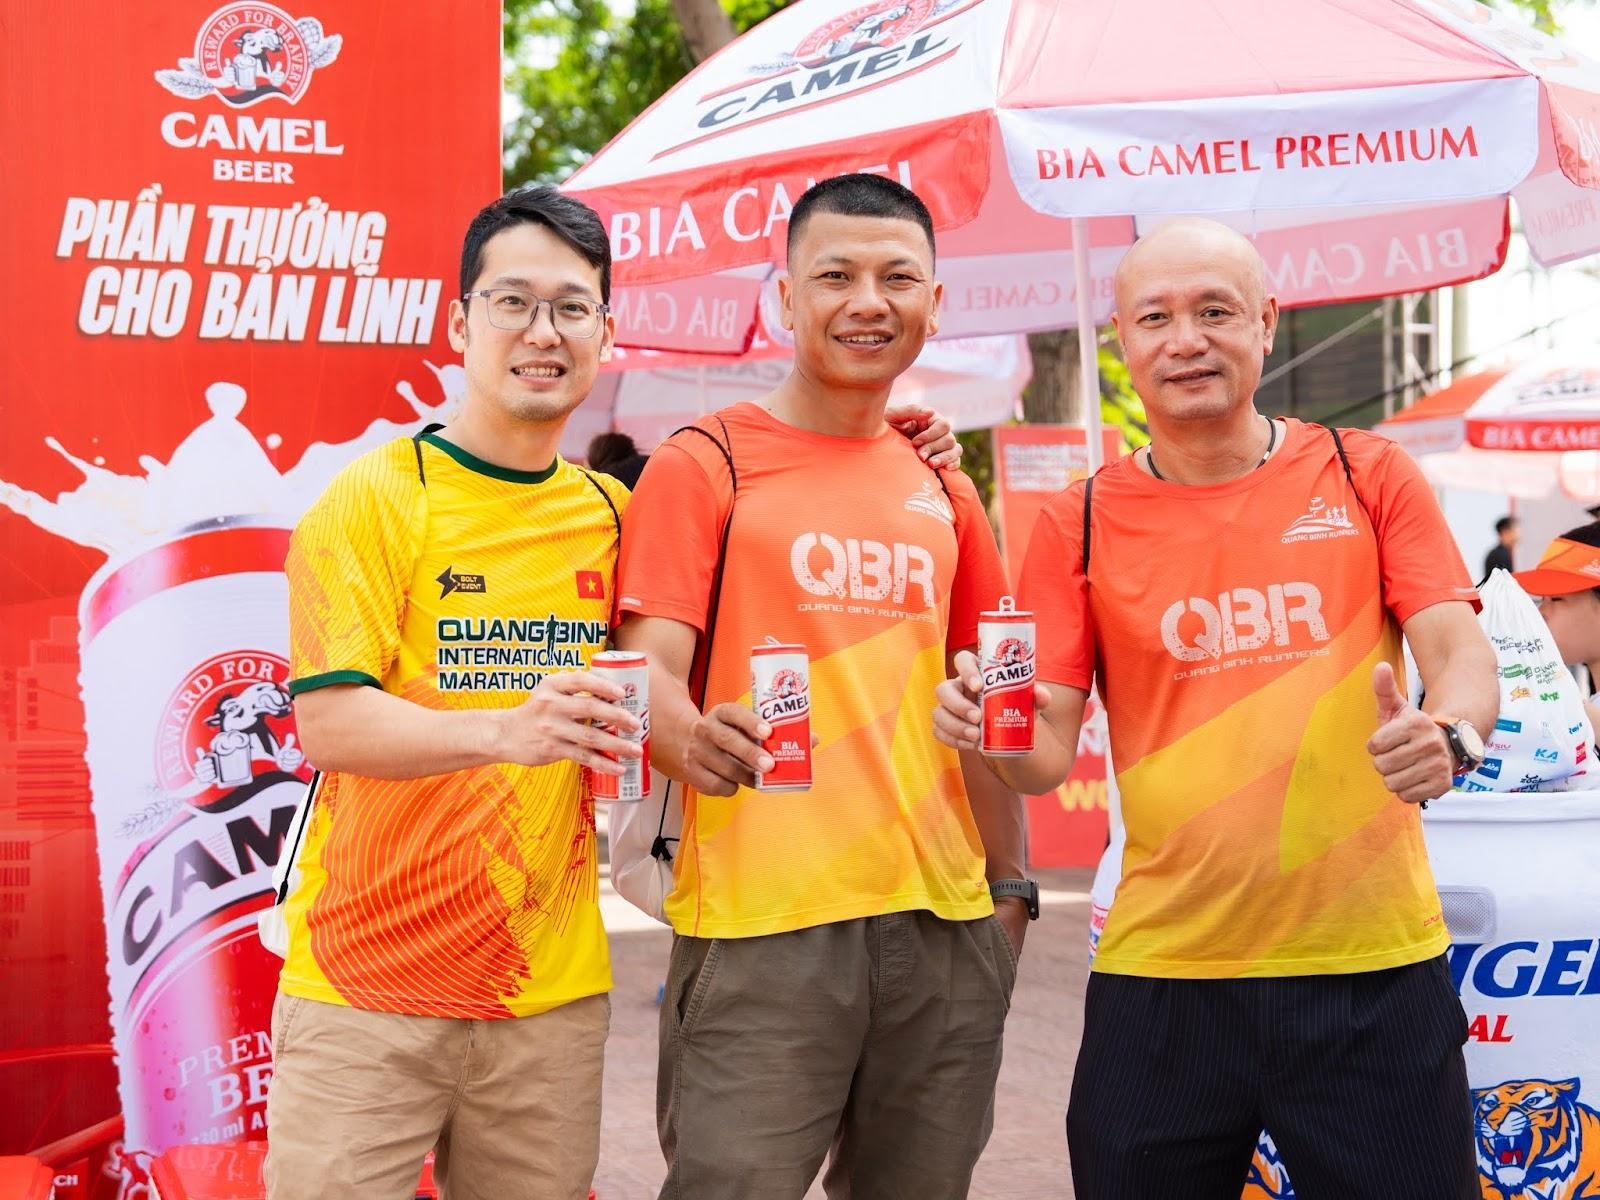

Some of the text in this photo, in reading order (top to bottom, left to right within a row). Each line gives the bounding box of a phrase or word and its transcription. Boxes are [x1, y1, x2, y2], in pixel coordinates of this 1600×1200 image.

[205, 10, 304, 91] REWARD FOR BRAVERY
[697, 34, 949, 128] CAMEL
[160, 112, 345, 155] CAMEL
[1036, 125, 1480, 181] BIA CAMEL PREMIUM
[213, 158, 294, 184] BEER
[56, 183, 388, 272] PHẦN THƯỞNG
[610, 201, 706, 262] BIA
[77, 256, 443, 345] CHO BẢN LĨNH
[1483, 426, 1525, 449] BIA
[1281, 534, 1309, 544] QUANG
[460, 575, 478, 583] BOLT
[790, 532, 936, 607] QBR
[797, 603, 844, 613] QUANG
[847, 605, 876, 616] BINH
[1160, 581, 1331, 662] QBR
[438, 619, 544, 641] QUANG
[220, 658, 275, 681] FOR
[439, 648, 585, 667] INTERNATIONAL
[1173, 648, 1331, 681] QUANG BINH RUNNERS
[985, 662, 1034, 686] CAMEL
[761, 694, 809, 720] CAMEL
[1003, 708, 1021, 717] BIA
[781, 741, 800, 750] BIA
[1468, 1014, 1514, 1043] AL
